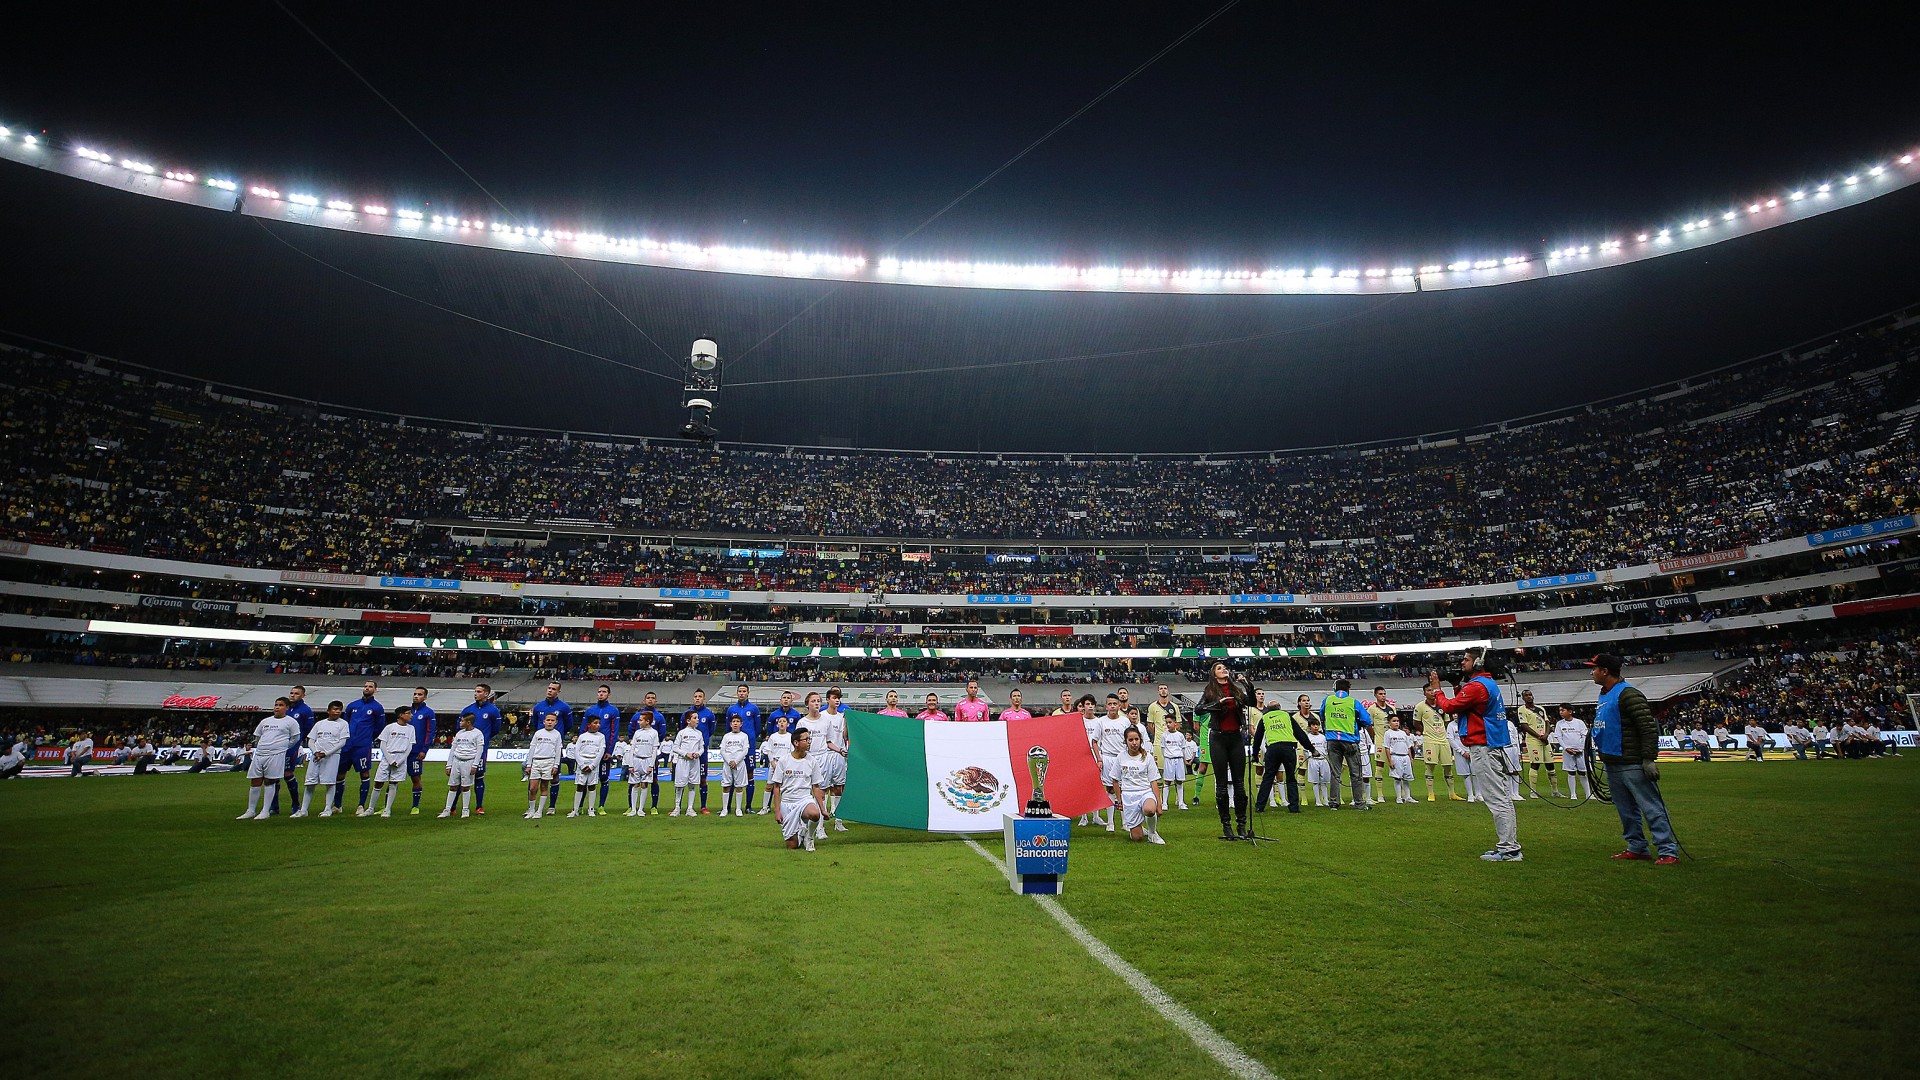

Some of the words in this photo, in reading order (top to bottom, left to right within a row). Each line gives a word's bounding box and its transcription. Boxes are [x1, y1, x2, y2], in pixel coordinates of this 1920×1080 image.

[1833, 529, 1852, 539] AT&T
[1883, 519, 1904, 529] AT&T
[1661, 561, 1679, 570] THE
[1682, 555, 1707, 567] HOME
[1709, 550, 1740, 562] DEPOT
[1537, 578, 1551, 586] AT&T
[1575, 574, 1590, 582] AT&T
[142, 597, 182, 607] Corona
[192, 601, 230, 611] Corona
[1615, 601, 1648, 612] Corona
[1655, 596, 1690, 608] Corona
[488, 617, 538, 626] caliente.mx
[1385, 621, 1432, 630] caliente.mx
[1113, 626, 1139, 635] Corona
[1298, 624, 1323, 635] Corona
[1329, 624, 1355, 633] Corona
[38, 750, 61, 758] THE
[1015, 839, 1032, 848] LIGA
[1049, 839, 1068, 848] BBVA
[1015, 847, 1068, 858] Bancomer
